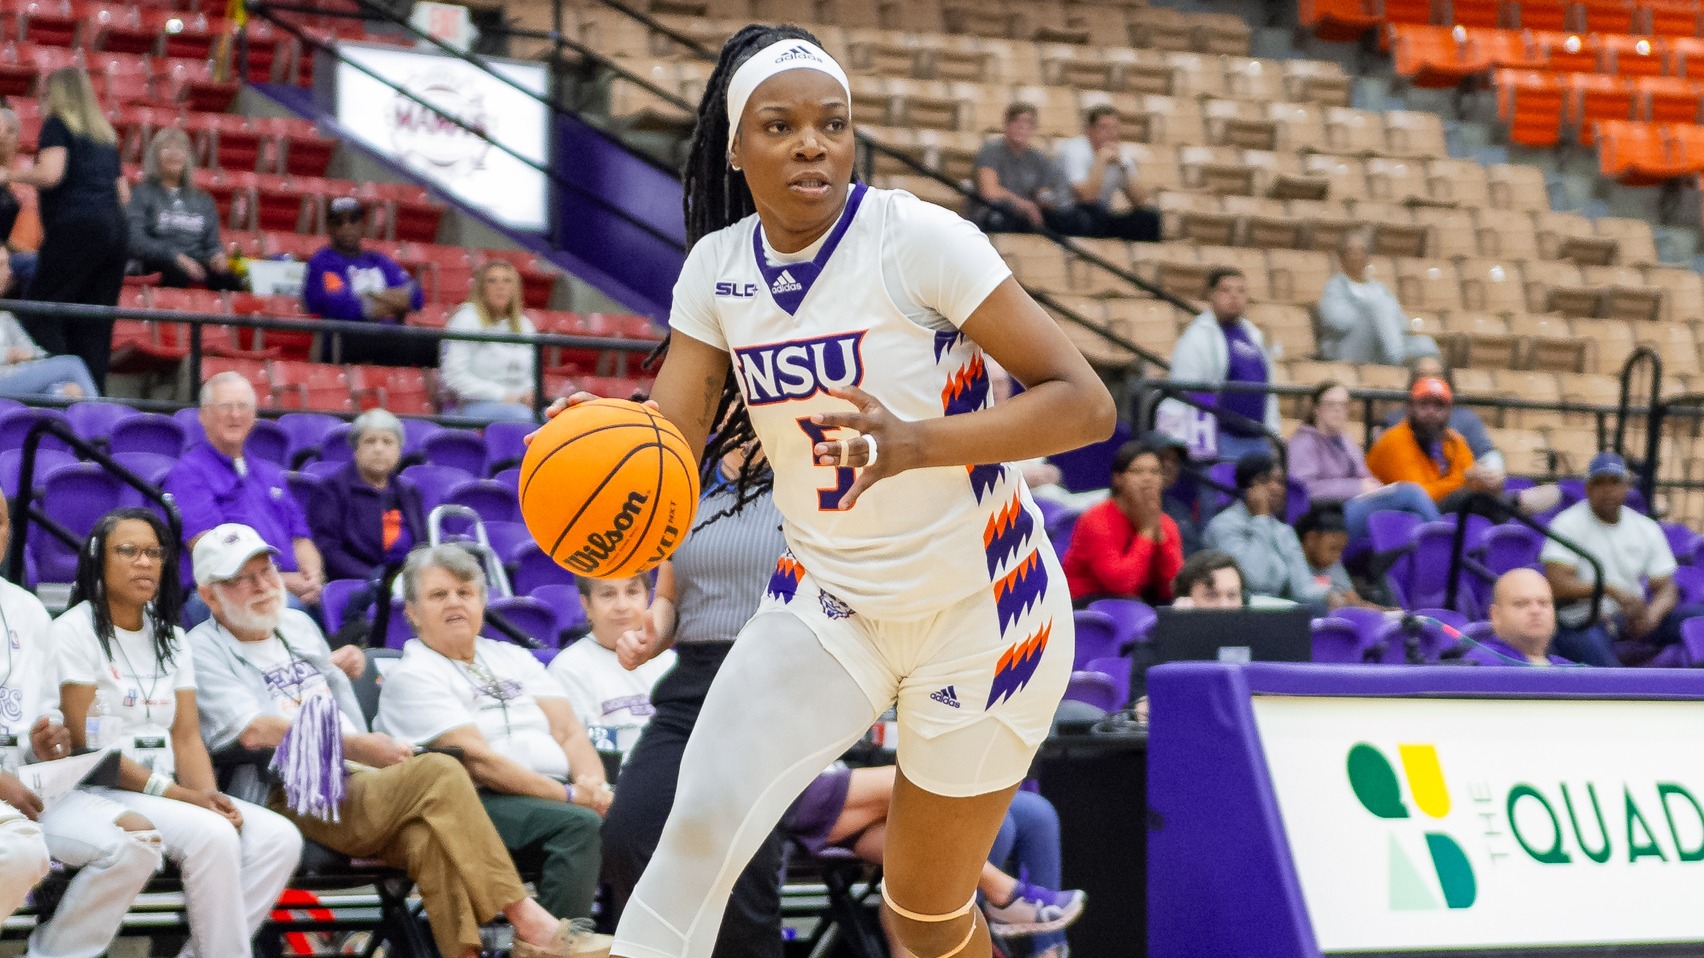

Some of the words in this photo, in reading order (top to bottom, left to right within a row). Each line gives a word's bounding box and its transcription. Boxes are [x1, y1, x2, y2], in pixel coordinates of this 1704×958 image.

[774, 51, 823, 63] adidas
[771, 282, 802, 294] adidas
[738, 336, 859, 402] NSU
[564, 491, 648, 573] Wilson
[929, 691, 961, 709] adidas
[1467, 780, 1509, 865] THE
[1505, 779, 1704, 865] QUAD
